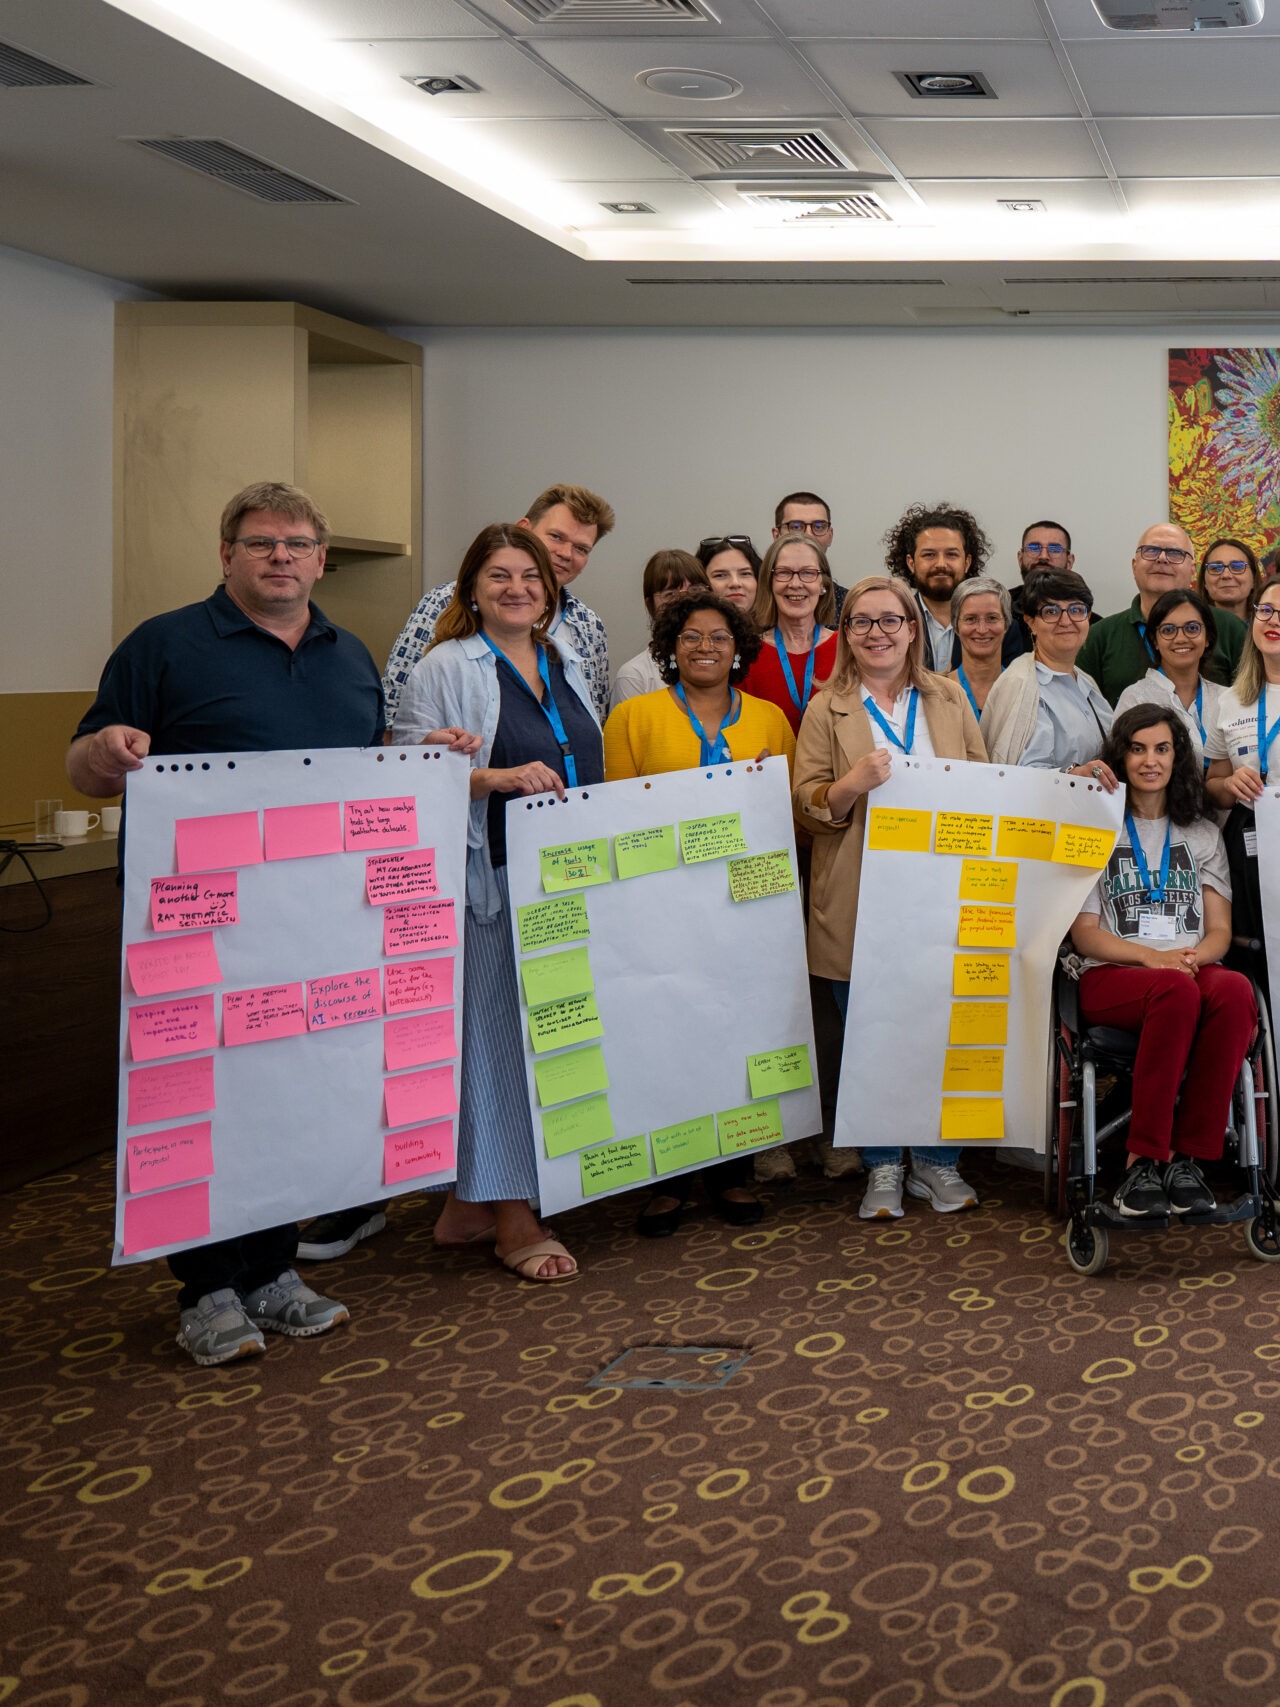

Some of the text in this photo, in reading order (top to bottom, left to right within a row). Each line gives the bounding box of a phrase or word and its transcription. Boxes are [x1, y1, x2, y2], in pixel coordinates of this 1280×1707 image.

[542, 847, 573, 857] Increase
[587, 854, 597, 863] by
[151, 881, 199, 894] Planning
[158, 893, 199, 905] another
[1123, 891, 1140, 908] LOS
[309, 976, 371, 996] Explore the
[313, 990, 372, 1010] discourse of
[136, 1010, 166, 1019] Inspire
[311, 1013, 327, 1025] AI
[343, 1007, 377, 1019] research
[394, 1140, 424, 1151] building
[404, 1148, 441, 1165] community
